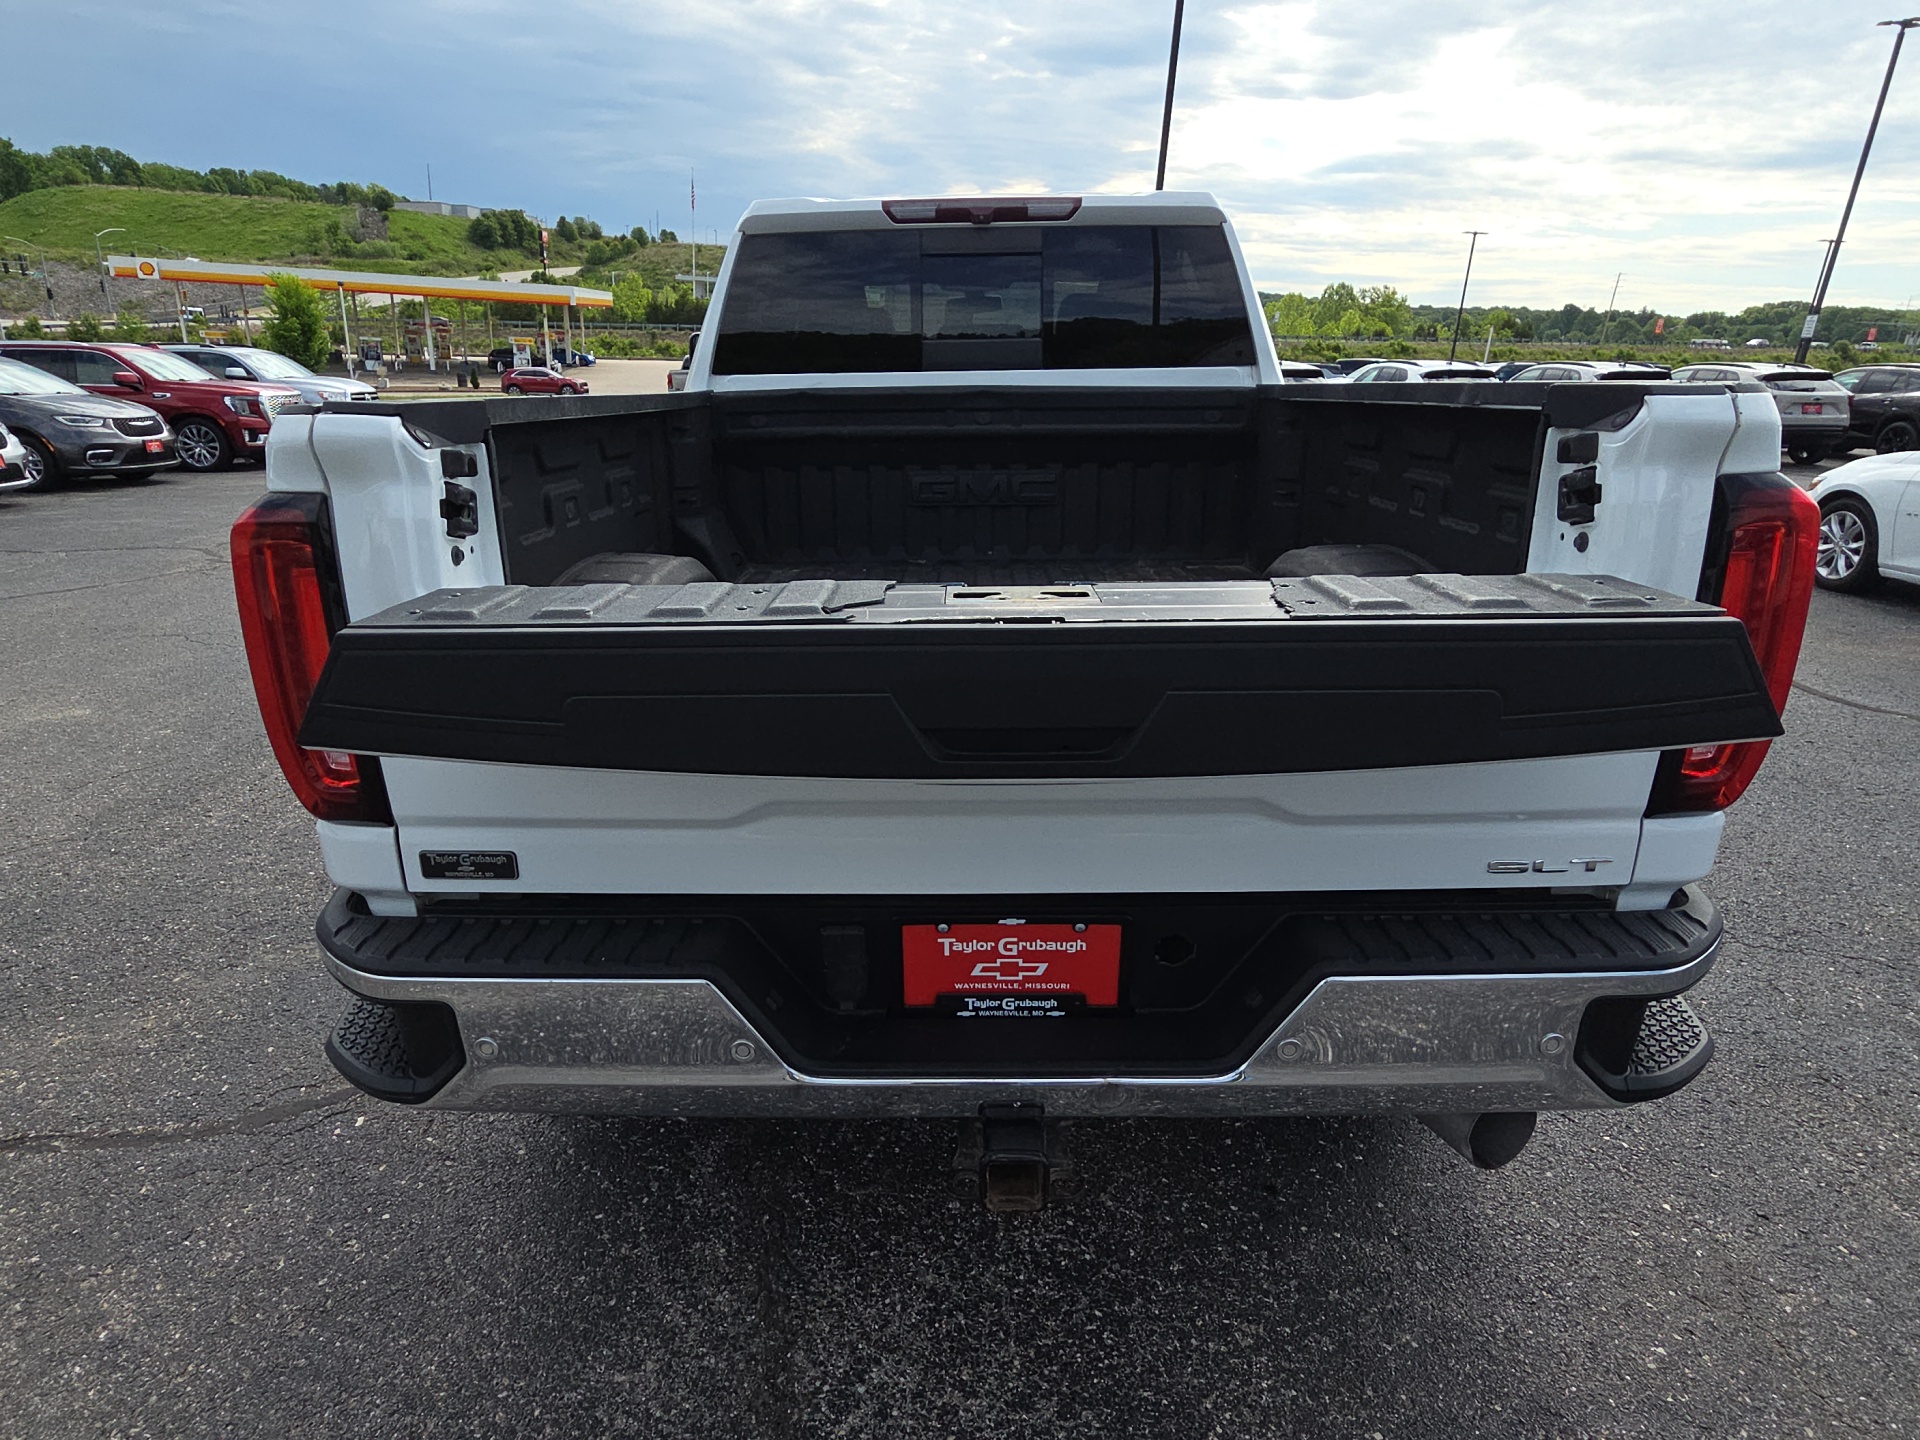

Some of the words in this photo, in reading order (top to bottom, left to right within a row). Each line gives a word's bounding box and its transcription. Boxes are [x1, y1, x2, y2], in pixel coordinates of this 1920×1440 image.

[911, 474, 1057, 502] GMC
[426, 853, 458, 866] Taylor
[459, 853, 507, 866] Grubaugh
[1487, 856, 1614, 874] SLT
[937, 937, 995, 956] Taylor
[998, 937, 1087, 956] Grubaugh
[964, 998, 1000, 1010] Taylor
[1002, 998, 1057, 1010] Grubaugh
